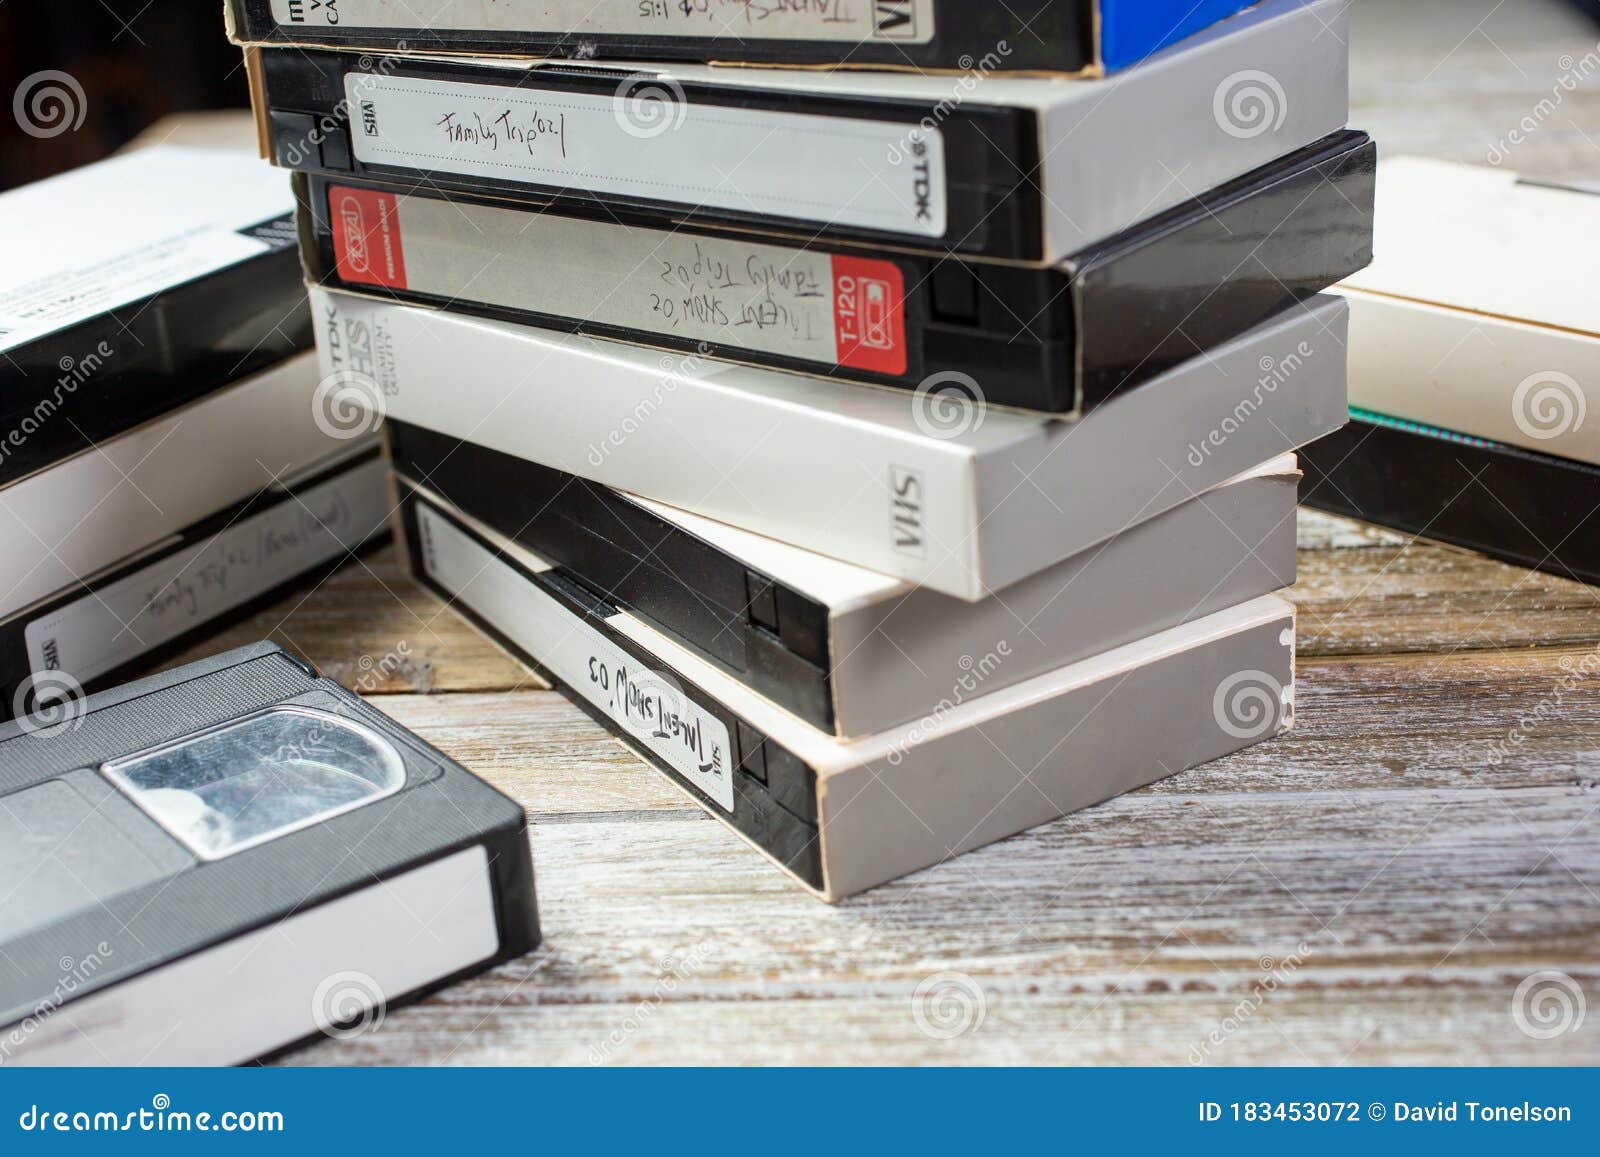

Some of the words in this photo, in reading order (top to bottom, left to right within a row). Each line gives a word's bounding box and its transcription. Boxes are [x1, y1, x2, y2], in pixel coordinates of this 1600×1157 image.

[361, 101, 378, 136] VHS
[913, 162, 931, 221] TDK
[326, 307, 342, 367] TDK
[838, 275, 858, 344] T-120
[42, 639, 60, 670] VHS
